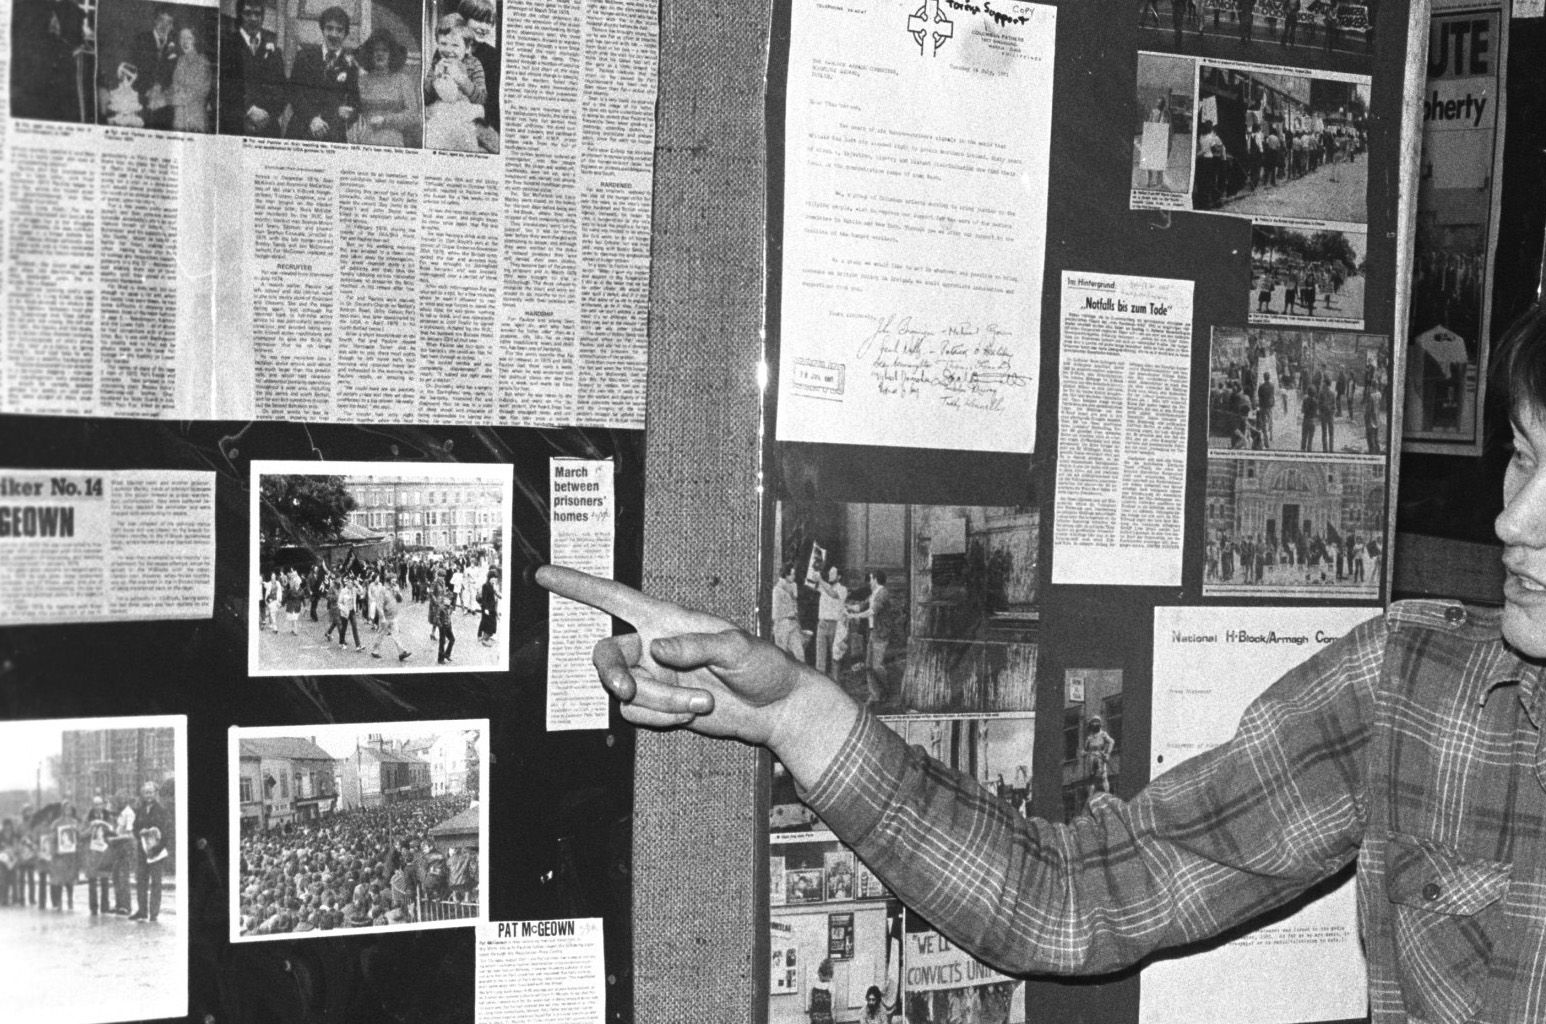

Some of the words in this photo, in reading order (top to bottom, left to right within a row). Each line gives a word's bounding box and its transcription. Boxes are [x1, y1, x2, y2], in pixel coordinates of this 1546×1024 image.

[1078, 278, 1115, 289] Hintergrund
[1118, 299, 1128, 312] bis
[1131, 304, 1147, 314] zum
[555, 466, 588, 478] March
[554, 480, 599, 492] between
[554, 495, 606, 508] prisoners'
[553, 510, 589, 521] homes
[1172, 630, 1218, 643] National
[498, 922, 518, 938] PAT
